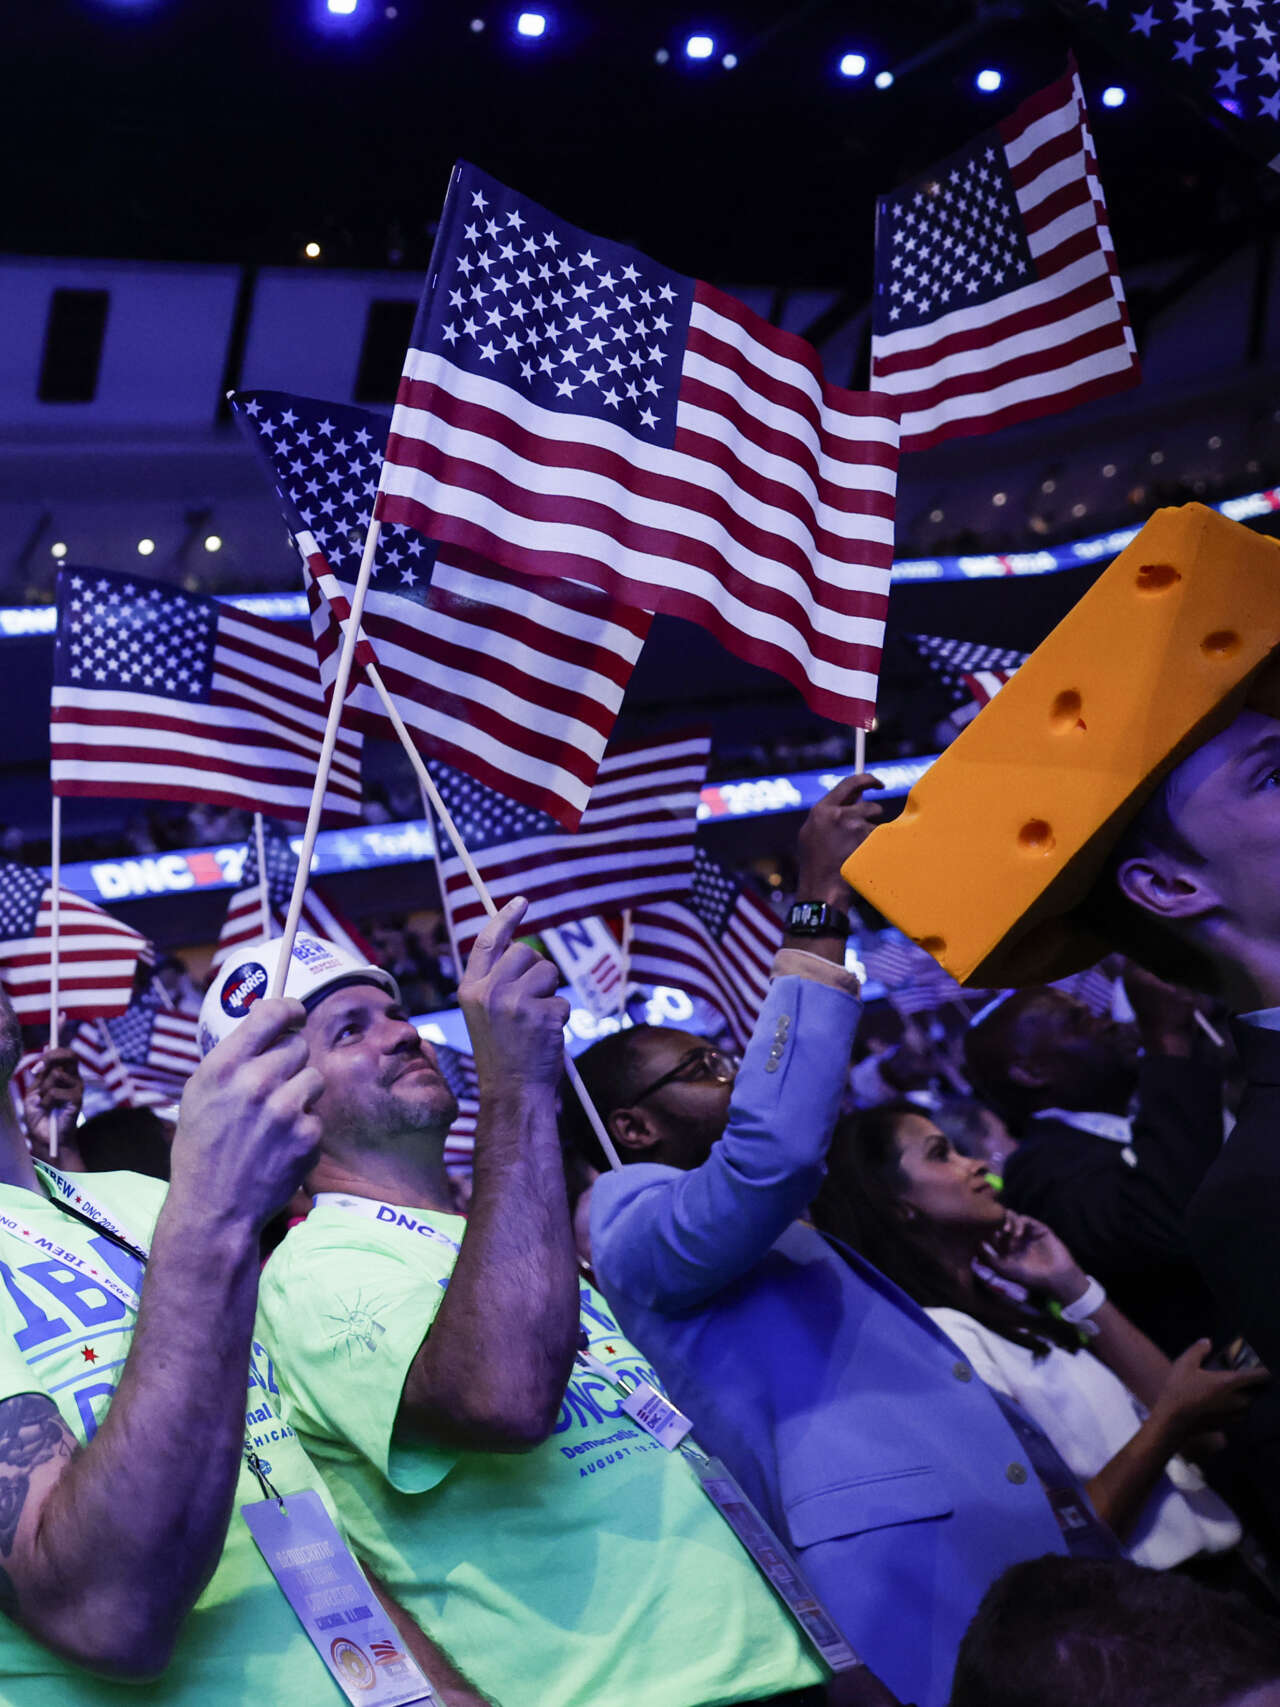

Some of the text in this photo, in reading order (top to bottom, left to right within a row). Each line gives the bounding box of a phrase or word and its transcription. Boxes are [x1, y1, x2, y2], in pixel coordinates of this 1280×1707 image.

[90, 855, 196, 900] DNC
[228, 969, 267, 1008] HARRIS
[81, 1201, 102, 1220] DNC
[376, 1205, 436, 1238] DNC
[34, 1237, 85, 1268] IBEW
[245, 1426, 297, 1451] CHICA
[579, 1447, 632, 1478] AUGUST
